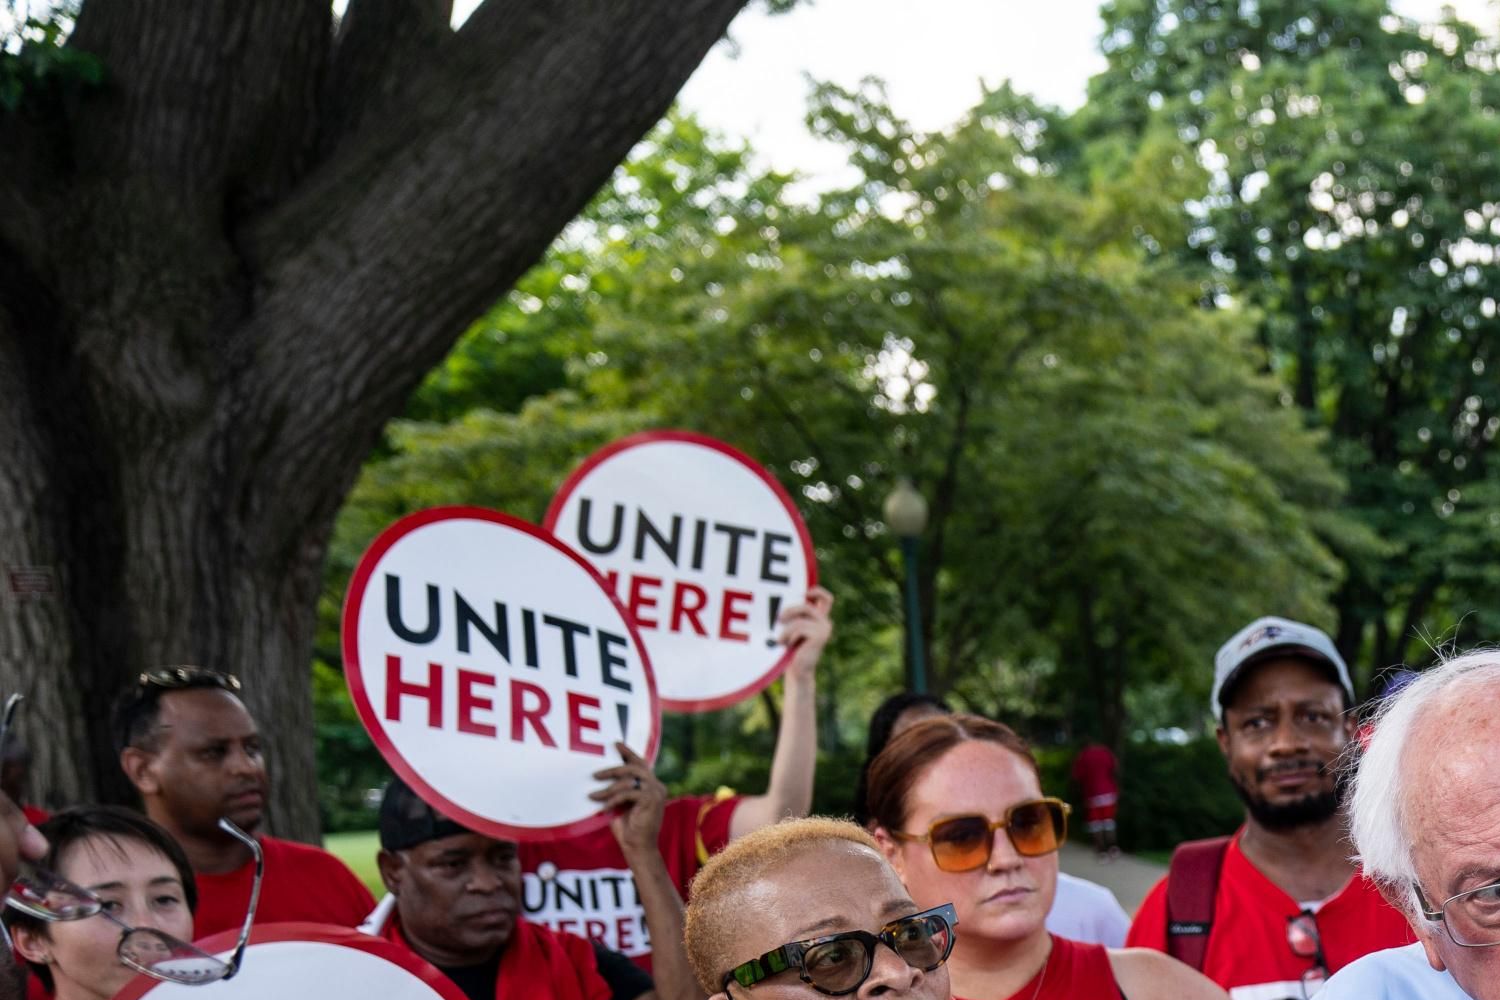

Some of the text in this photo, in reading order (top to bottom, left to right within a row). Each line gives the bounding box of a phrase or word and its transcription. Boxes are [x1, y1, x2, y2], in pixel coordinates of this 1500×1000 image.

[577, 497, 793, 585] UNITE
[384, 571, 633, 693] UNITE
[605, 570, 783, 648] ERE!
